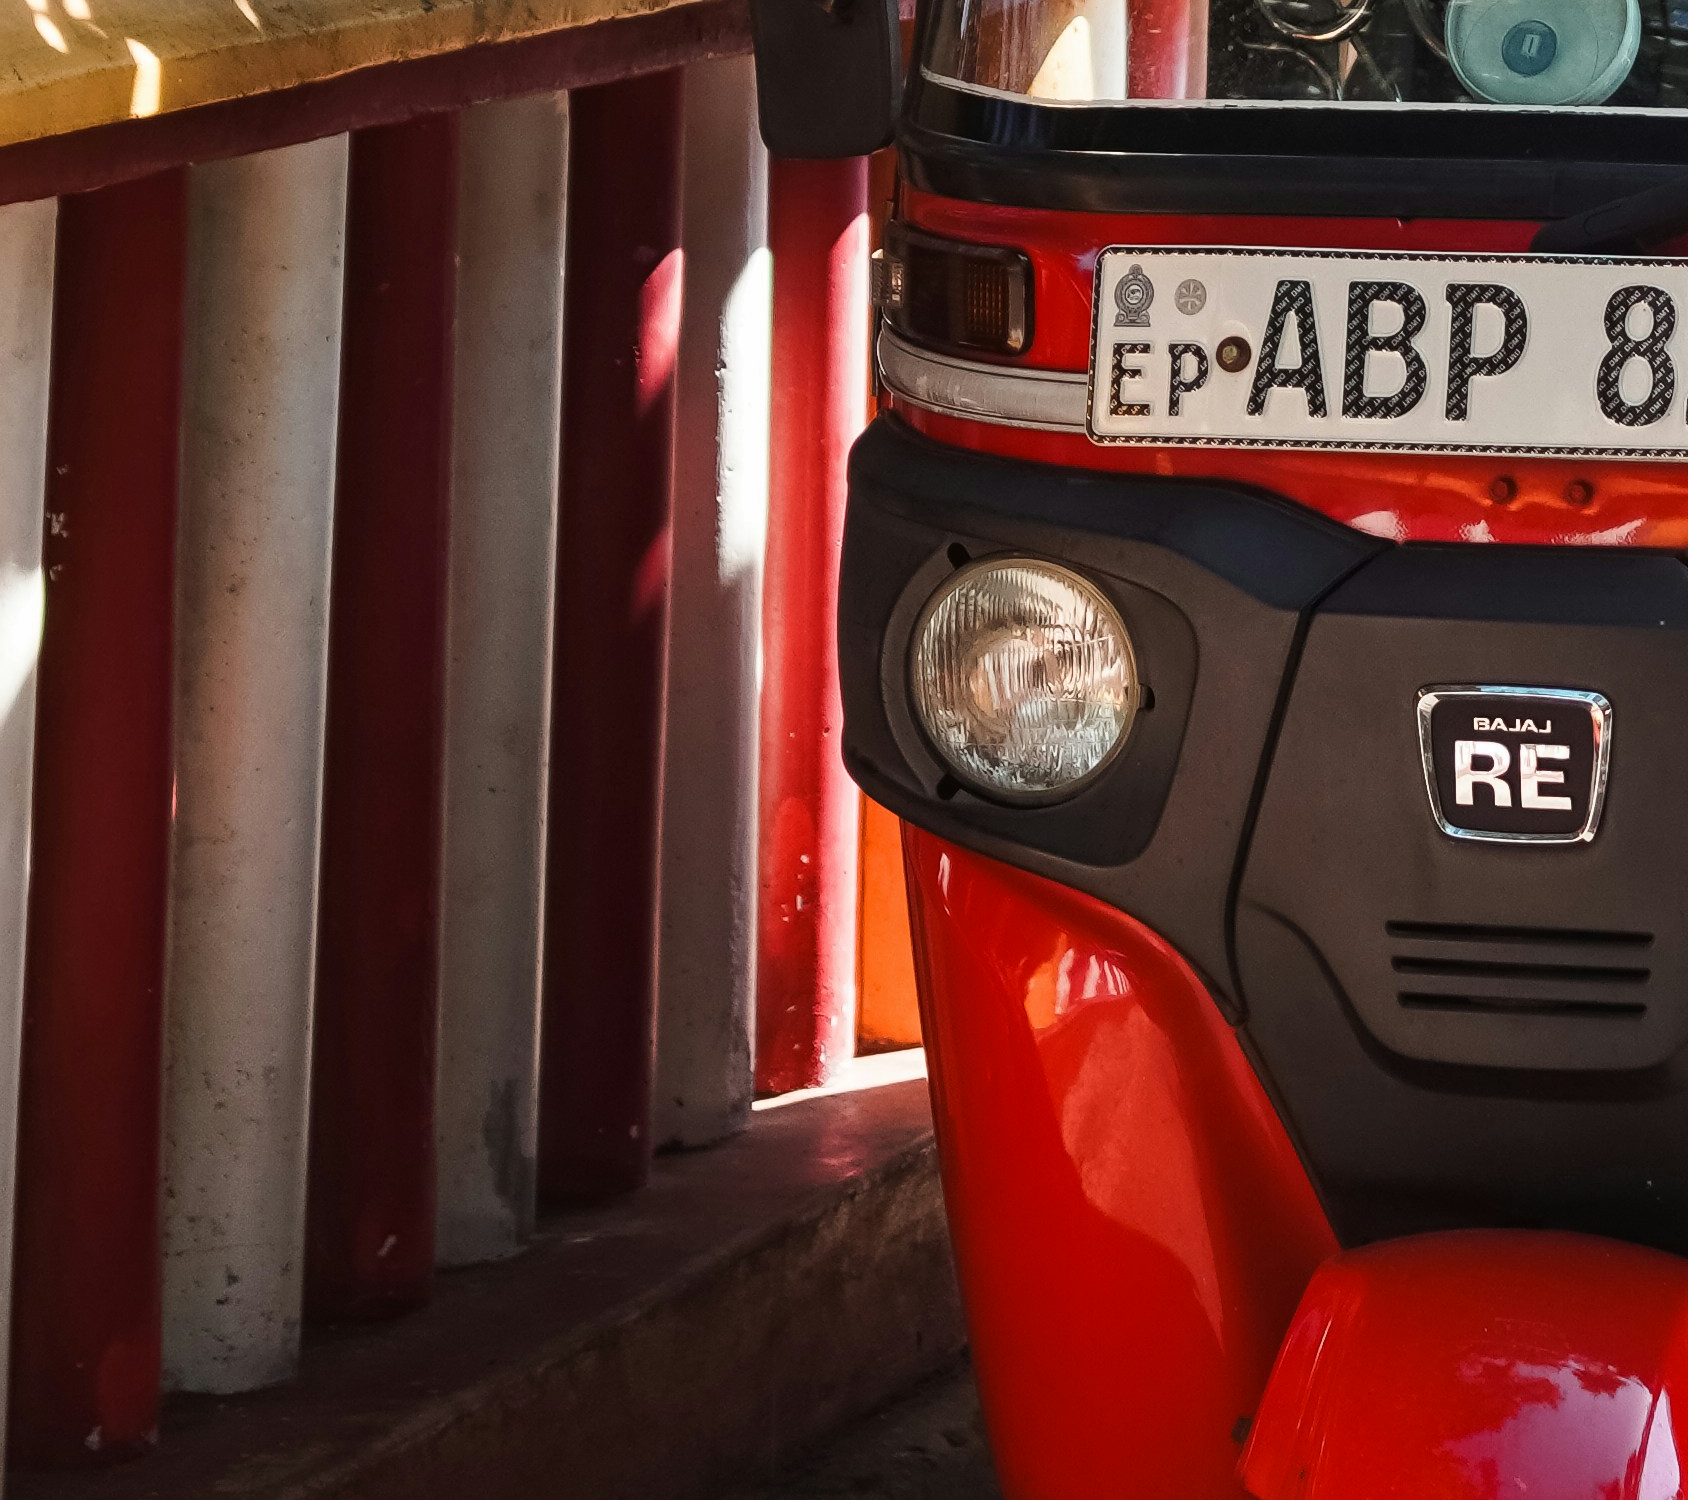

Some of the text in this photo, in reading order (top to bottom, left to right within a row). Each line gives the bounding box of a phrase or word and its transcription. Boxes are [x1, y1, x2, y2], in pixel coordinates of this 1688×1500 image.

[1110, 343, 1209, 416] EP
[1247, 280, 1529, 421] ABP
[1473, 717, 1552, 733] BAJAJ
[1454, 740, 1572, 810] RE
